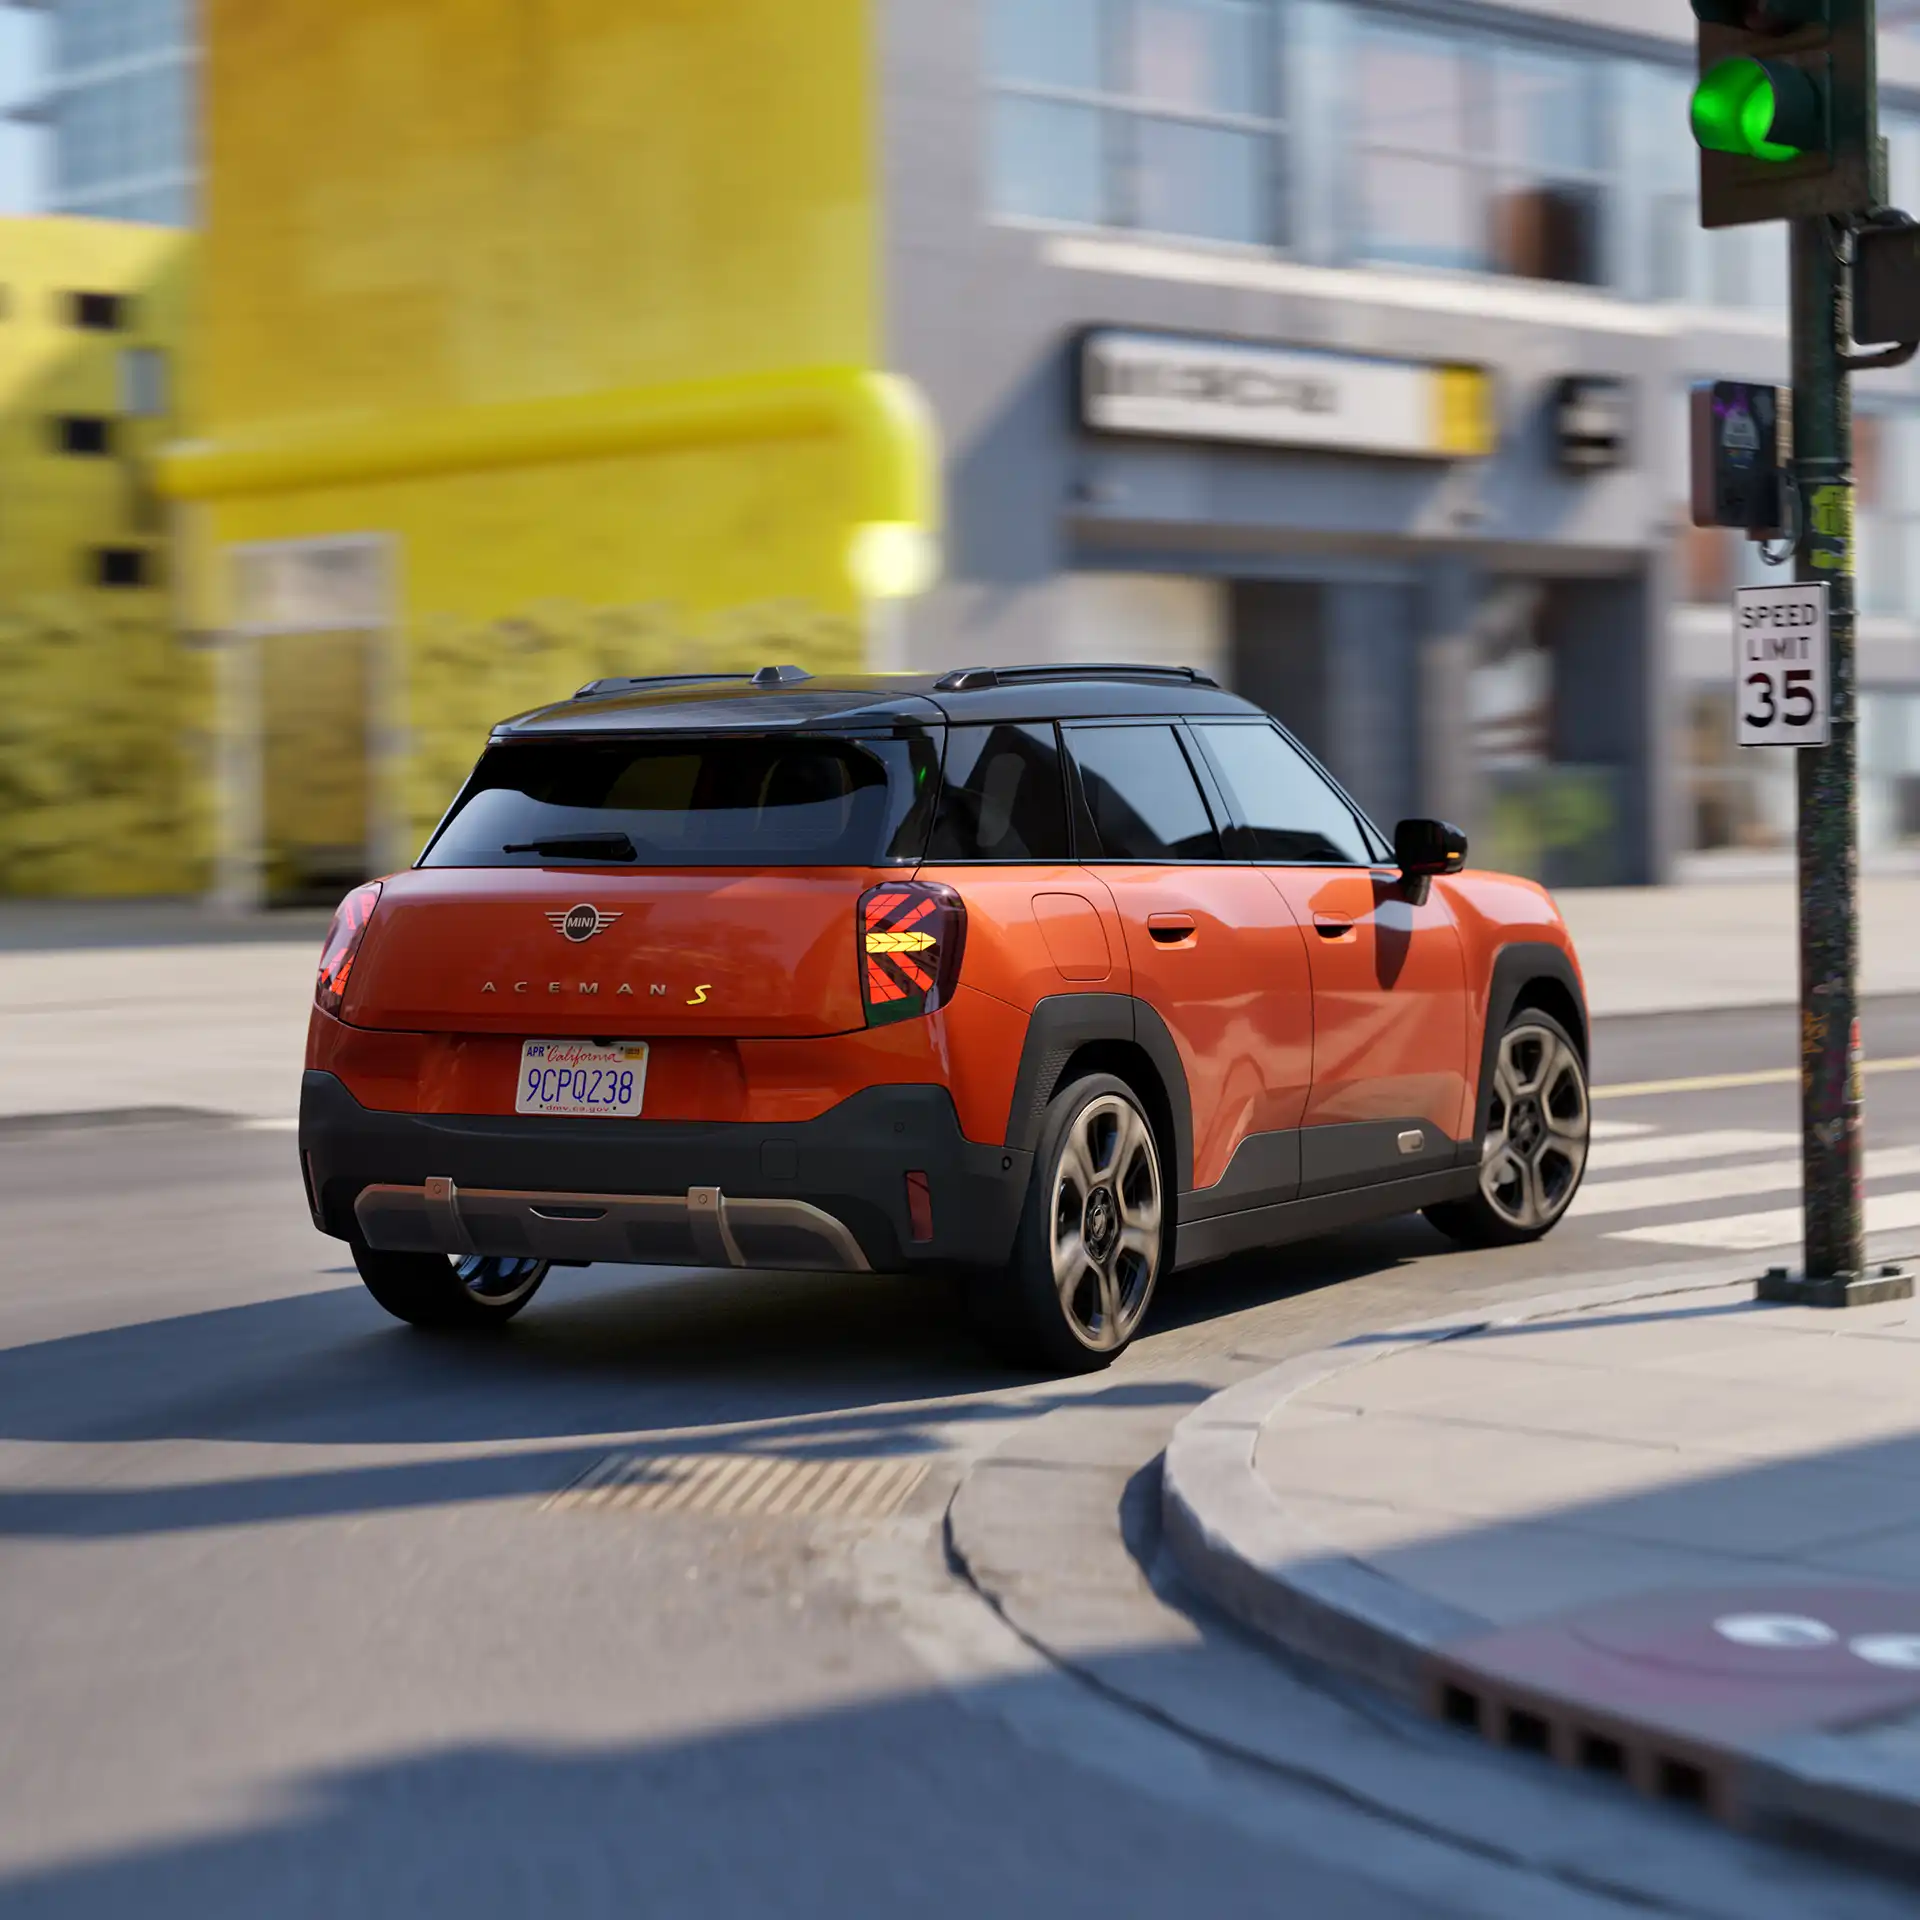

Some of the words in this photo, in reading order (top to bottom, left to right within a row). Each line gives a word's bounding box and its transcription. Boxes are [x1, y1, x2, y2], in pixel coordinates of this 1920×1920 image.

[1740, 604, 1817, 628] SPEED
[1747, 636, 1810, 661] LIMIT
[1744, 669, 1815, 728] 35
[567, 916, 594, 928] MINI
[481, 981, 666, 995] ACEMAN
[686, 984, 712, 1005] S
[527, 1046, 544, 1057] APR
[547, 1045, 622, 1067] California
[526, 1068, 633, 1104] 9CPQ238
